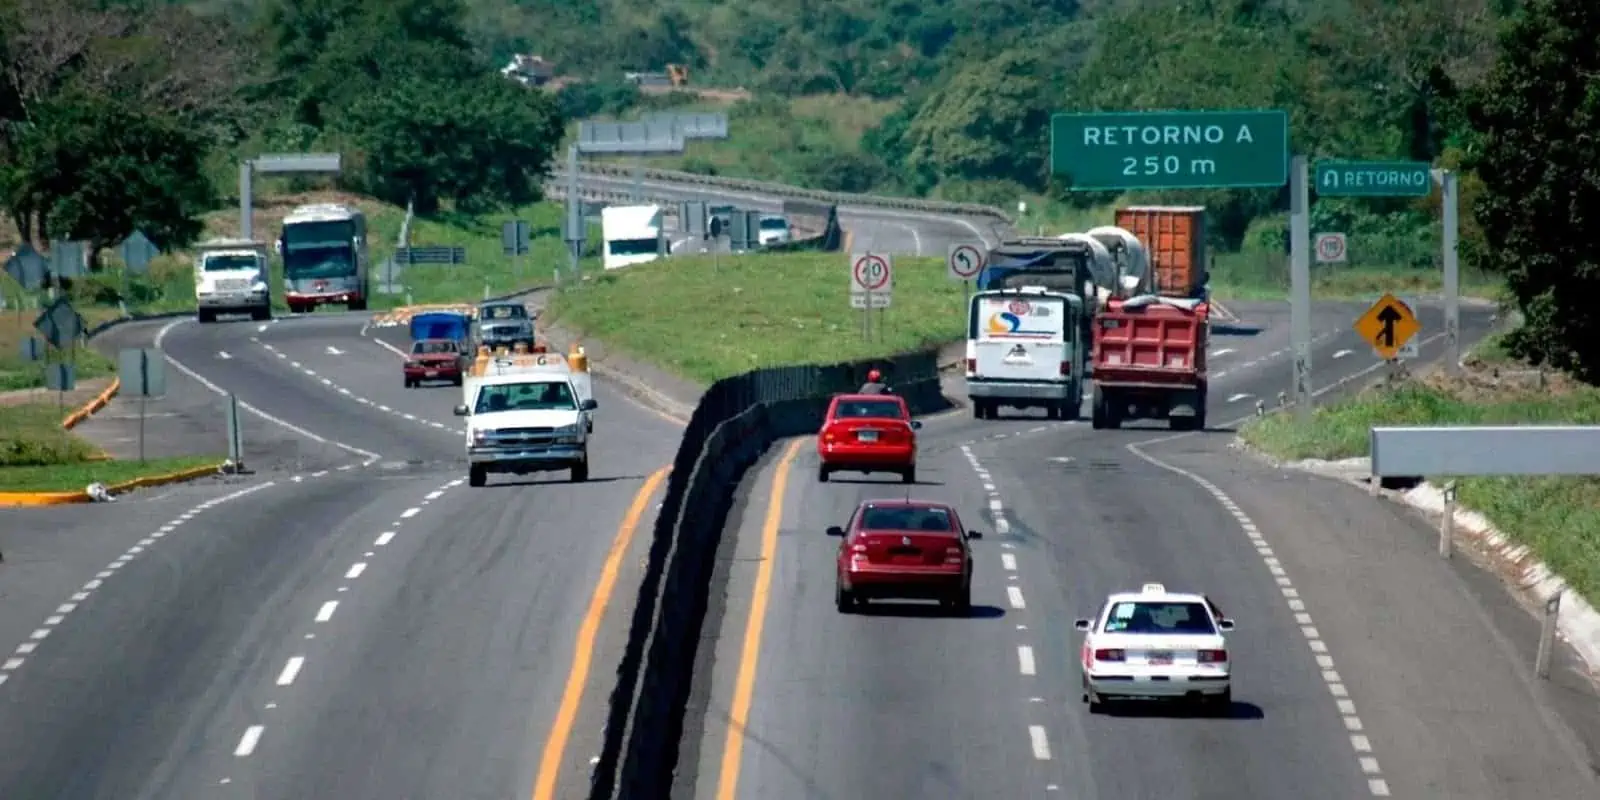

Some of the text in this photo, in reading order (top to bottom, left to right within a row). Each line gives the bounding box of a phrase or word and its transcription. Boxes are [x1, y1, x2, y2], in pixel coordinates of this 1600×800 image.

[1083, 124, 1253, 145] RETORNO A
[1122, 155, 1216, 175] 250 m
[1344, 170, 1425, 187] RETORNO
